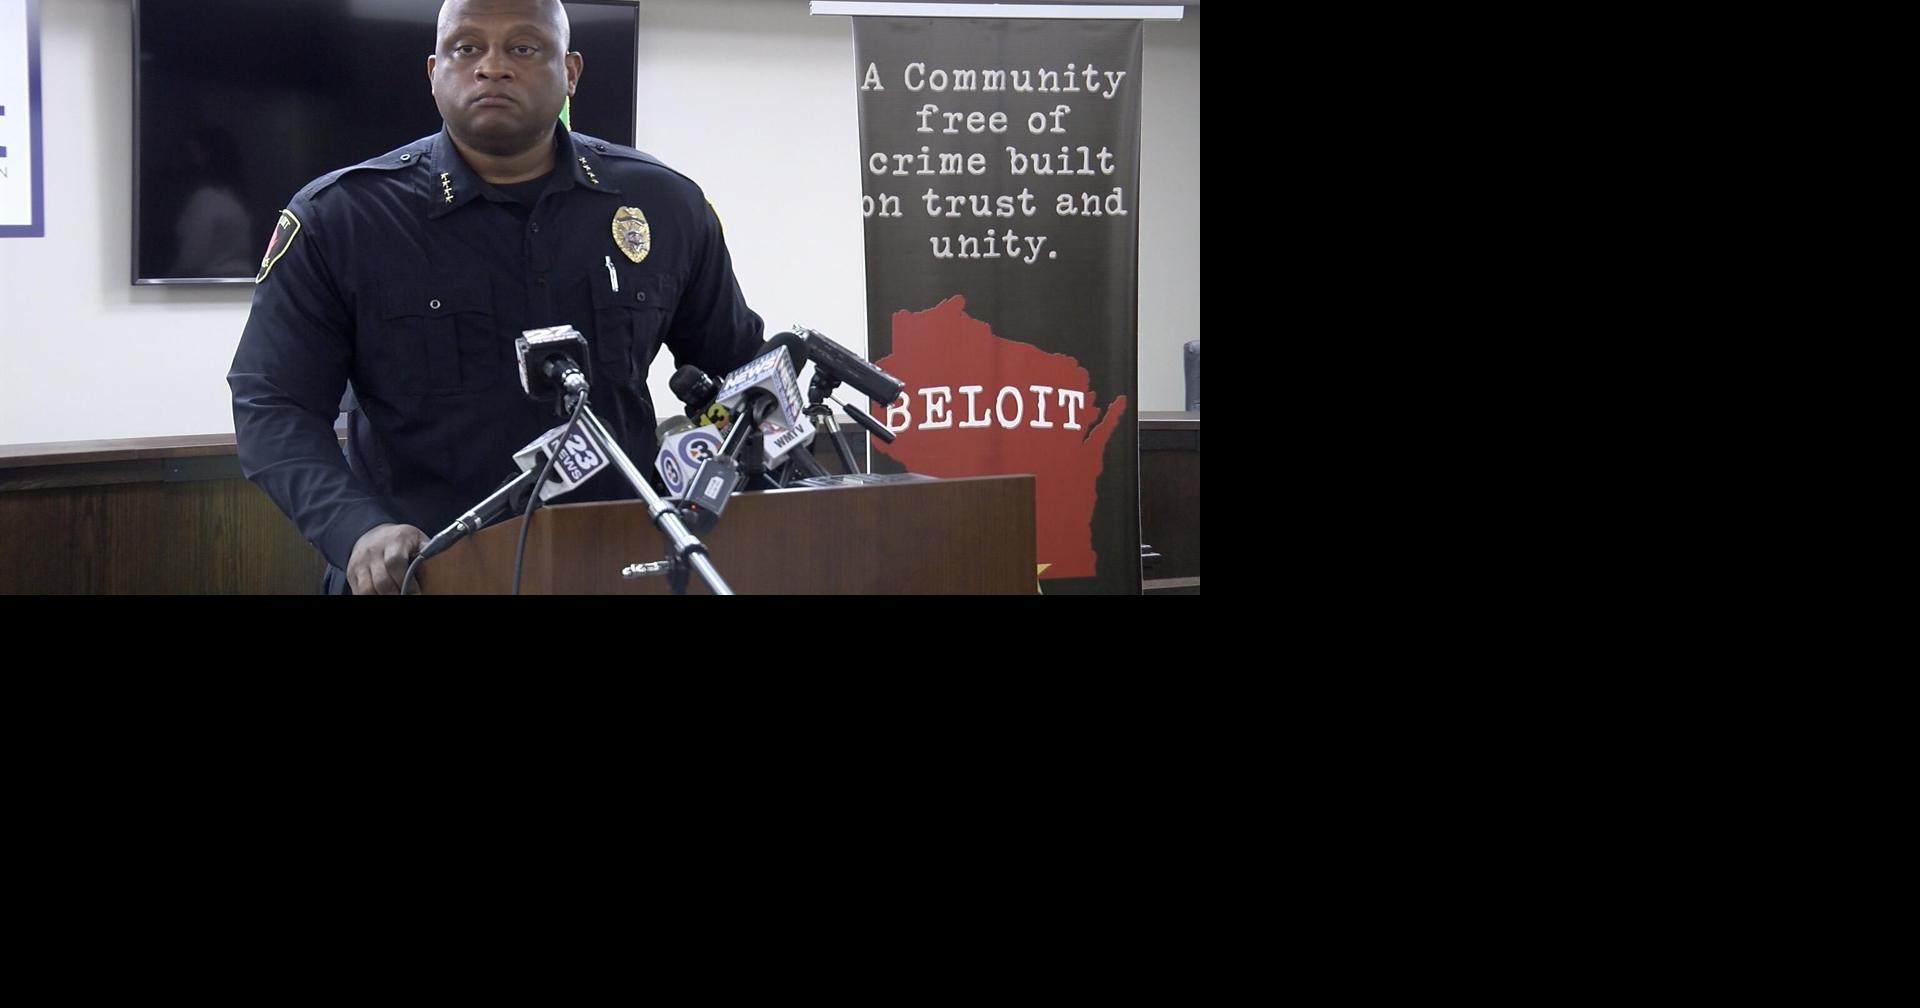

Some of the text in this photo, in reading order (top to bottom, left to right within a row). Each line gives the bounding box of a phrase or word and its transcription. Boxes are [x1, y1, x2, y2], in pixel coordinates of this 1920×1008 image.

[861, 62, 1126, 98] A Community
[916, 104, 1071, 134] free of
[869, 146, 1115, 176] crime built
[862, 187, 1128, 218] on trust and
[930, 229, 1057, 263] unity.
[886, 385, 1085, 432] BELOIT
[564, 434, 600, 470] 23
[690, 440, 714, 461] 3
[773, 423, 805, 449] WMTV
[549, 439, 583, 480] NEWS
